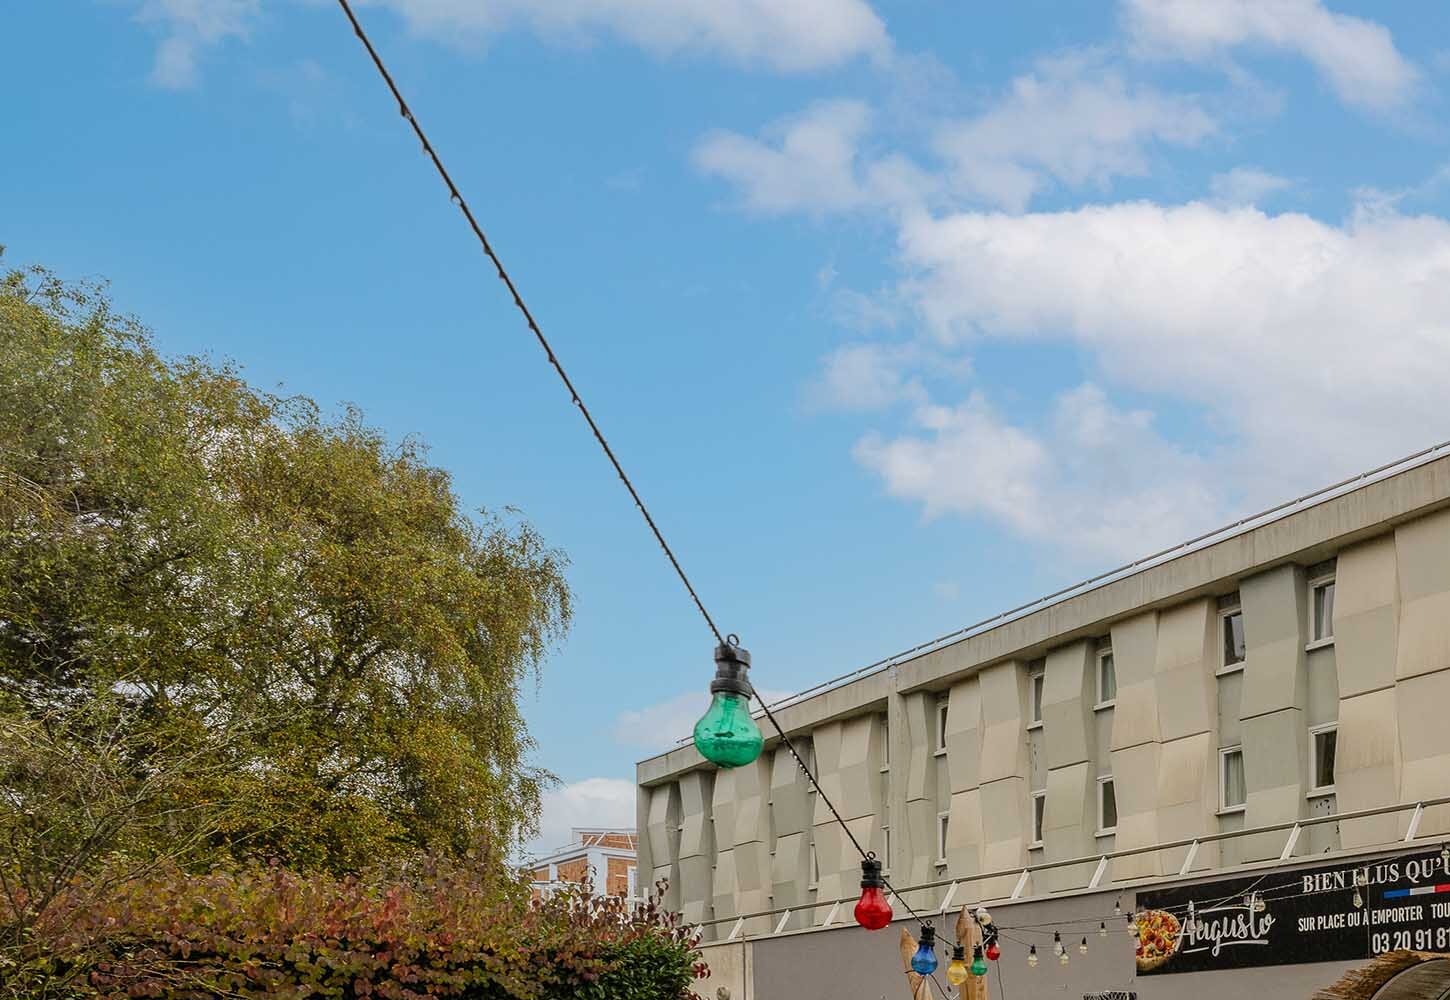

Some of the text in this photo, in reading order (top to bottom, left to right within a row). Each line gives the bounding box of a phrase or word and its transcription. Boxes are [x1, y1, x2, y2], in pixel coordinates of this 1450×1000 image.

[1302, 870, 1346, 894] BIEN
[1175, 889, 1276, 957] Augusto
[1298, 917, 1315, 932] SUR
[1317, 913, 1345, 930] PLACE
[1347, 911, 1360, 927] OU
[1362, 908, 1369, 926] À
[1372, 905, 1423, 925] EMPORTER
[1372, 933, 1390, 954] 03
[1393, 930, 1411, 951] 20
[1415, 928, 1432, 950] 91
